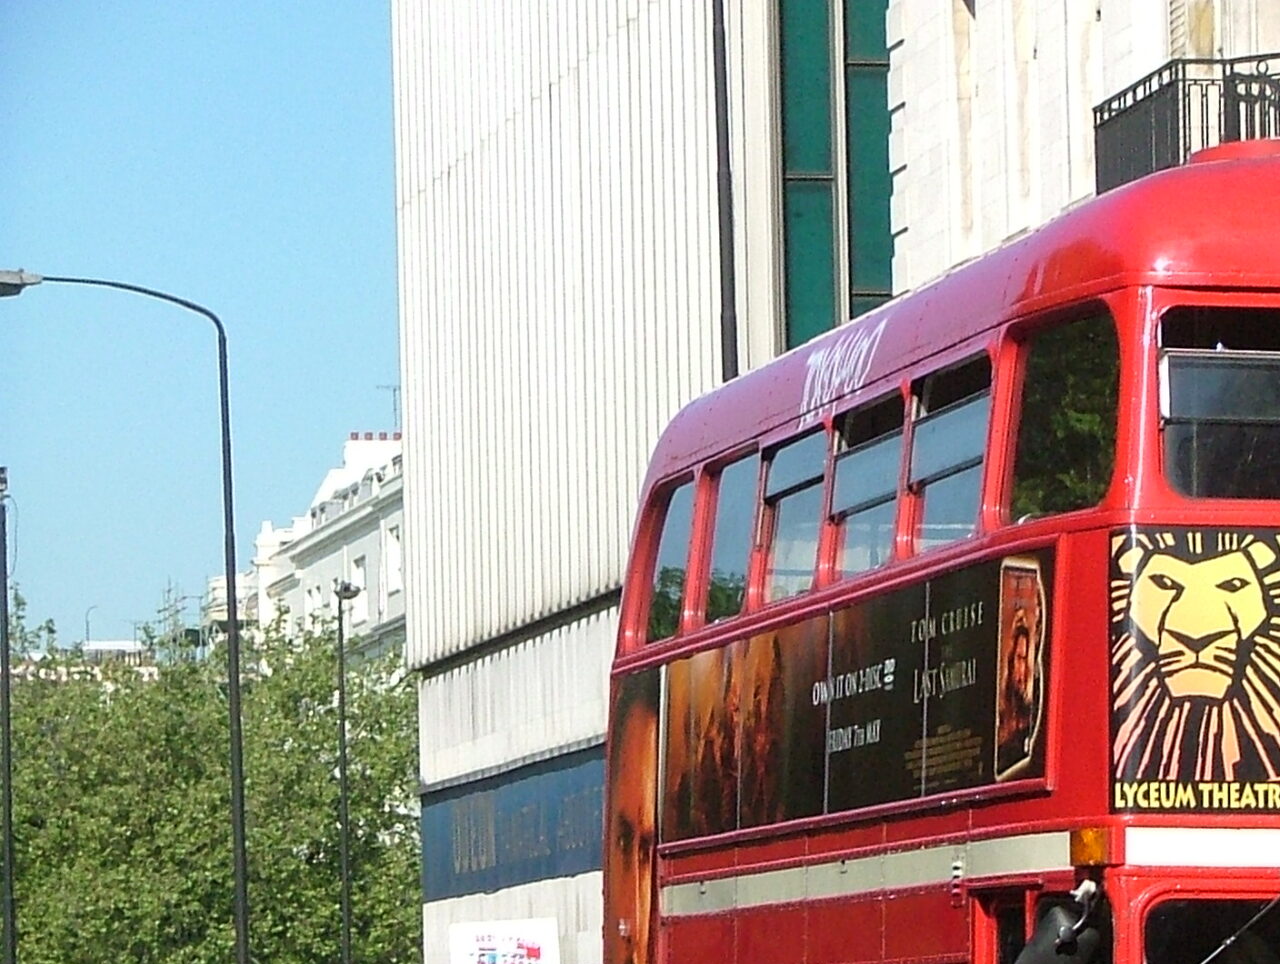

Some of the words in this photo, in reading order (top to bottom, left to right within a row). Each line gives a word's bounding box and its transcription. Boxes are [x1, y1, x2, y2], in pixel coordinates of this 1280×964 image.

[910, 617, 937, 643] TOM
[941, 600, 984, 635] CRUISE
[1114, 782, 1197, 809] LYCEUM
